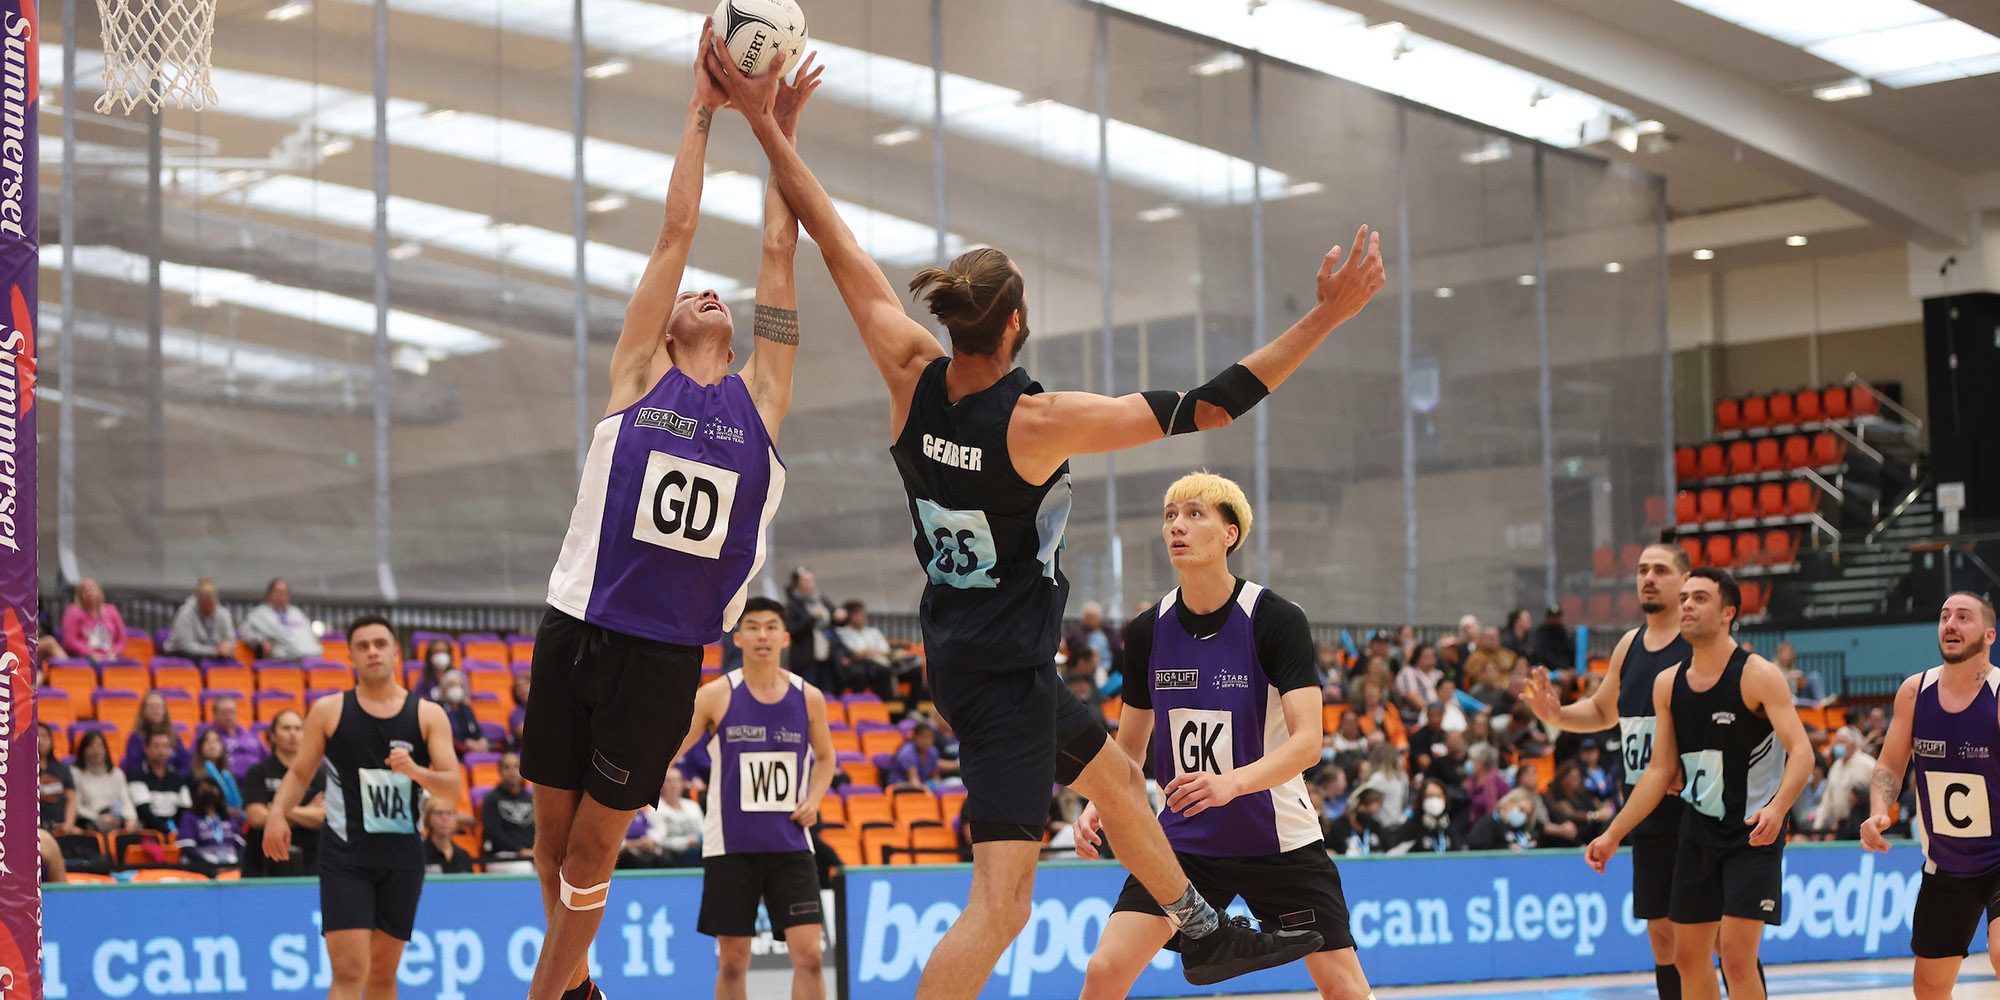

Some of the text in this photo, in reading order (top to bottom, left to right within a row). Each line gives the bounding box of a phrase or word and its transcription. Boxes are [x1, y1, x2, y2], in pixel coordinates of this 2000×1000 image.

[739, 31, 767, 77] LBERT
[1, 11, 32, 240] Summerset
[0, 324, 25, 553] Summerset
[640, 410, 660, 420] RIG
[670, 414, 695, 431] LIFT
[716, 425, 744, 436] STARS
[922, 433, 983, 472] GERBER
[652, 470, 719, 541] GD
[933, 527, 978, 576] GS
[1178, 672, 1196, 681] LIFT
[1626, 733, 1652, 770] GA
[368, 785, 408, 819] WA
[749, 761, 789, 802] WD
[1944, 783, 1973, 829] C
[1352, 897, 1452, 949] can
[1465, 877, 1608, 956] sleep
[1764, 853, 1921, 953] bedp
[92, 935, 247, 997] can
[269, 910, 485, 1000] slep
[508, 926, 602, 983] o
[622, 901, 675, 977] it
[859, 880, 1175, 996] bepo
